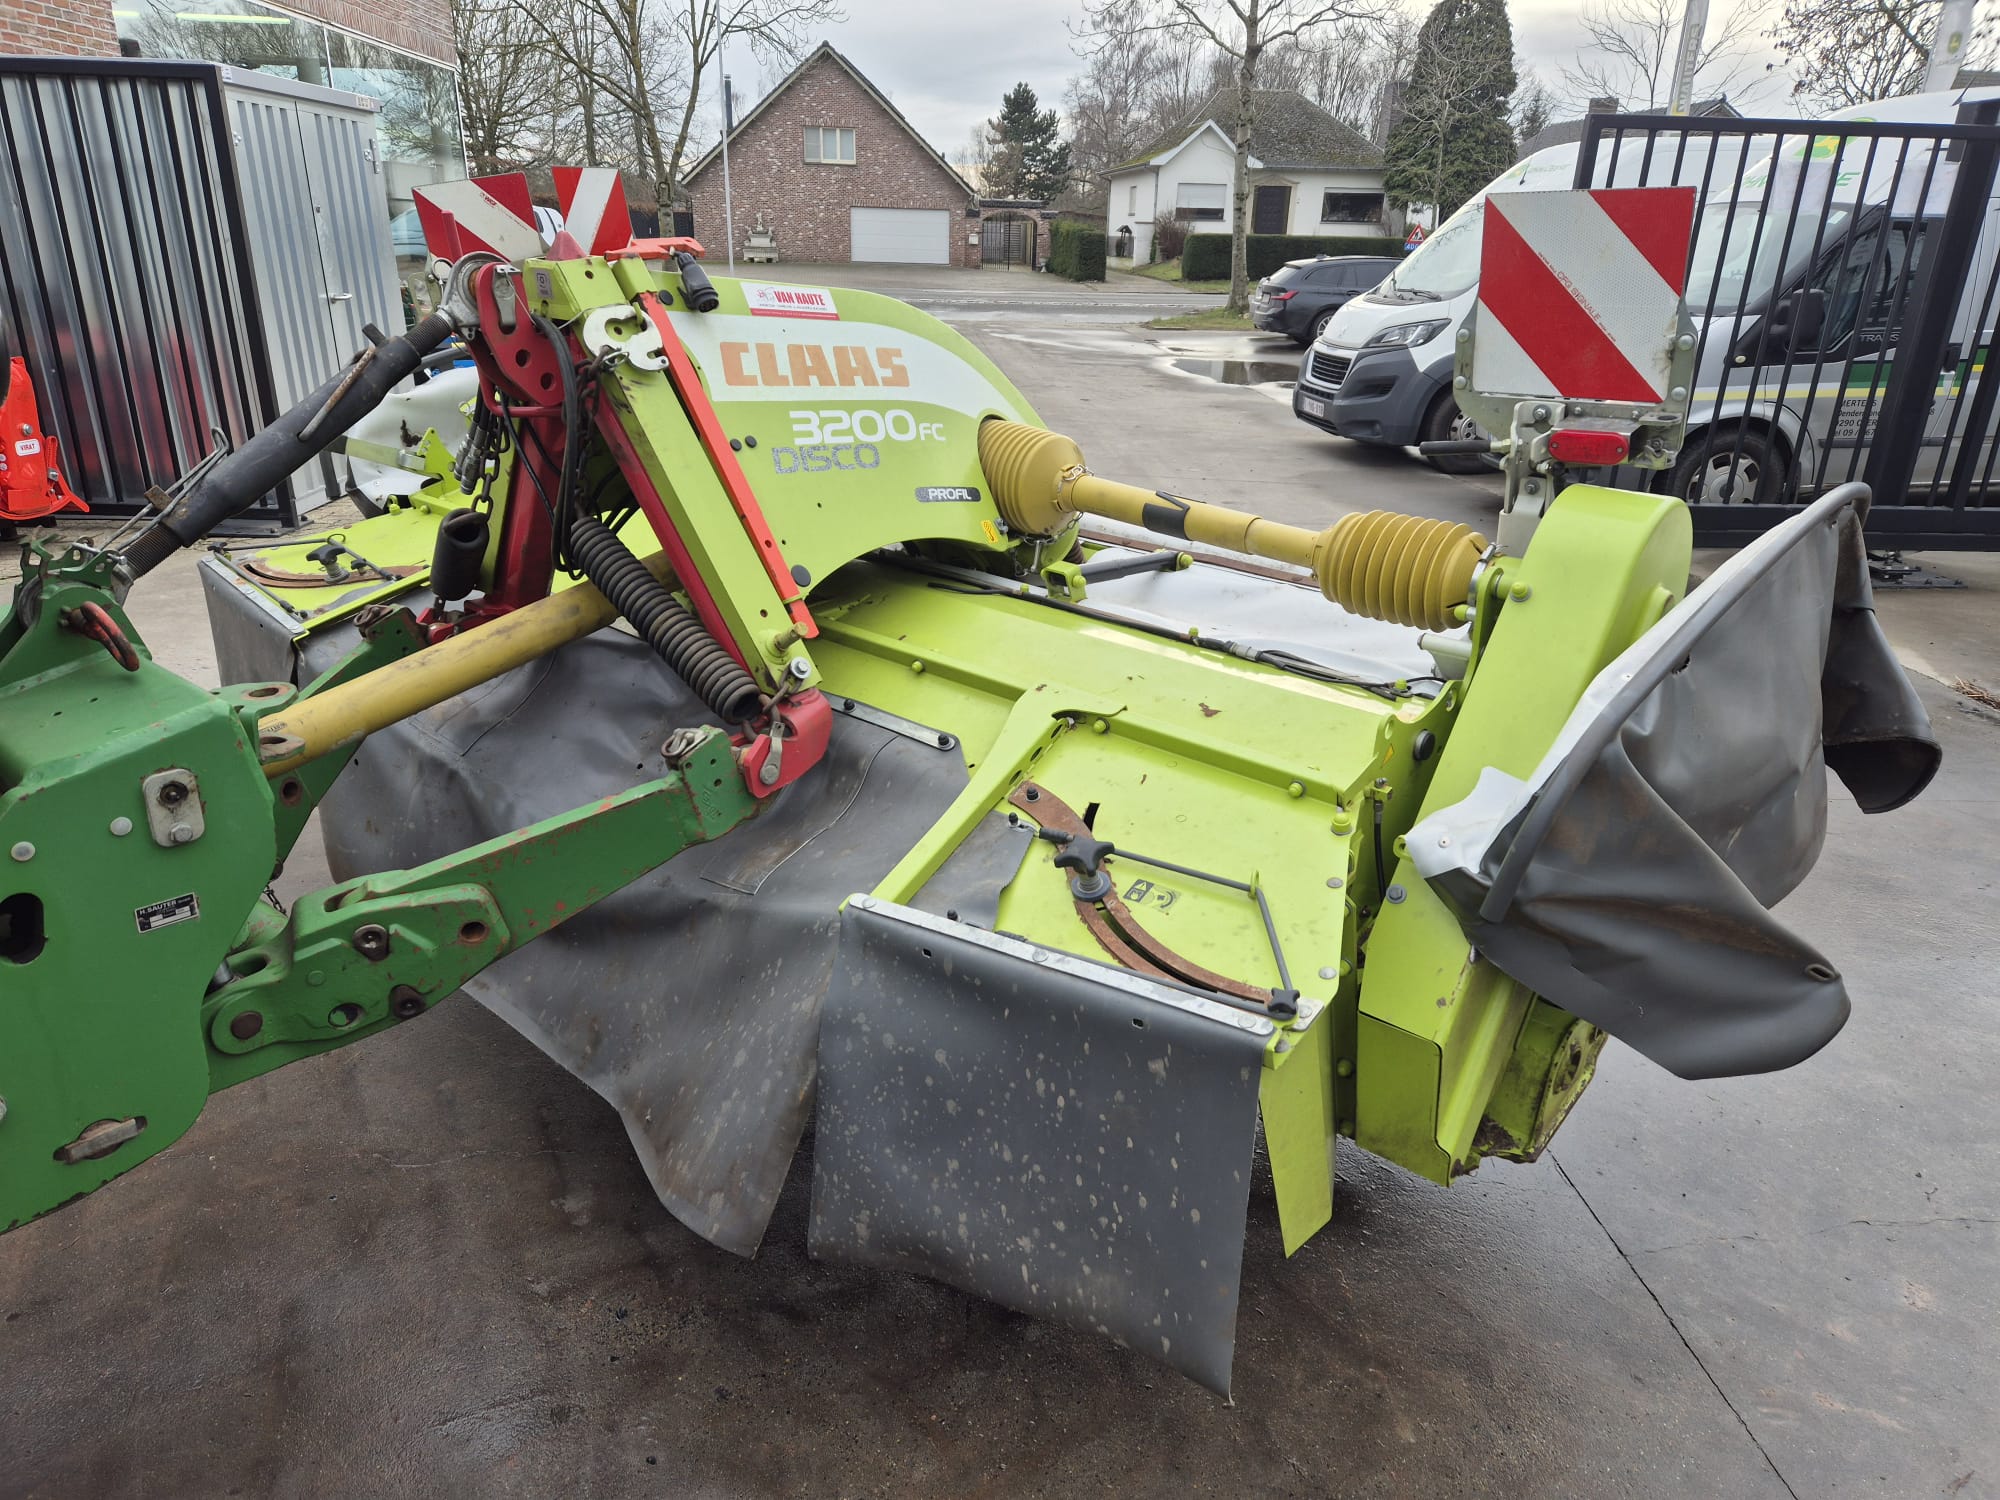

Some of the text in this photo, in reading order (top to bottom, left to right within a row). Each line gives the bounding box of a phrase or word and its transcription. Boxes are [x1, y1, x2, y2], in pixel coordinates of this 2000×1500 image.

[774, 290, 826, 306] VAN HAUTE
[719, 341, 910, 388] CLAAS
[1837, 419, 1855, 427] 290
[772, 443, 881, 475] DISCO
[928, 488, 972, 500] PROFIL
